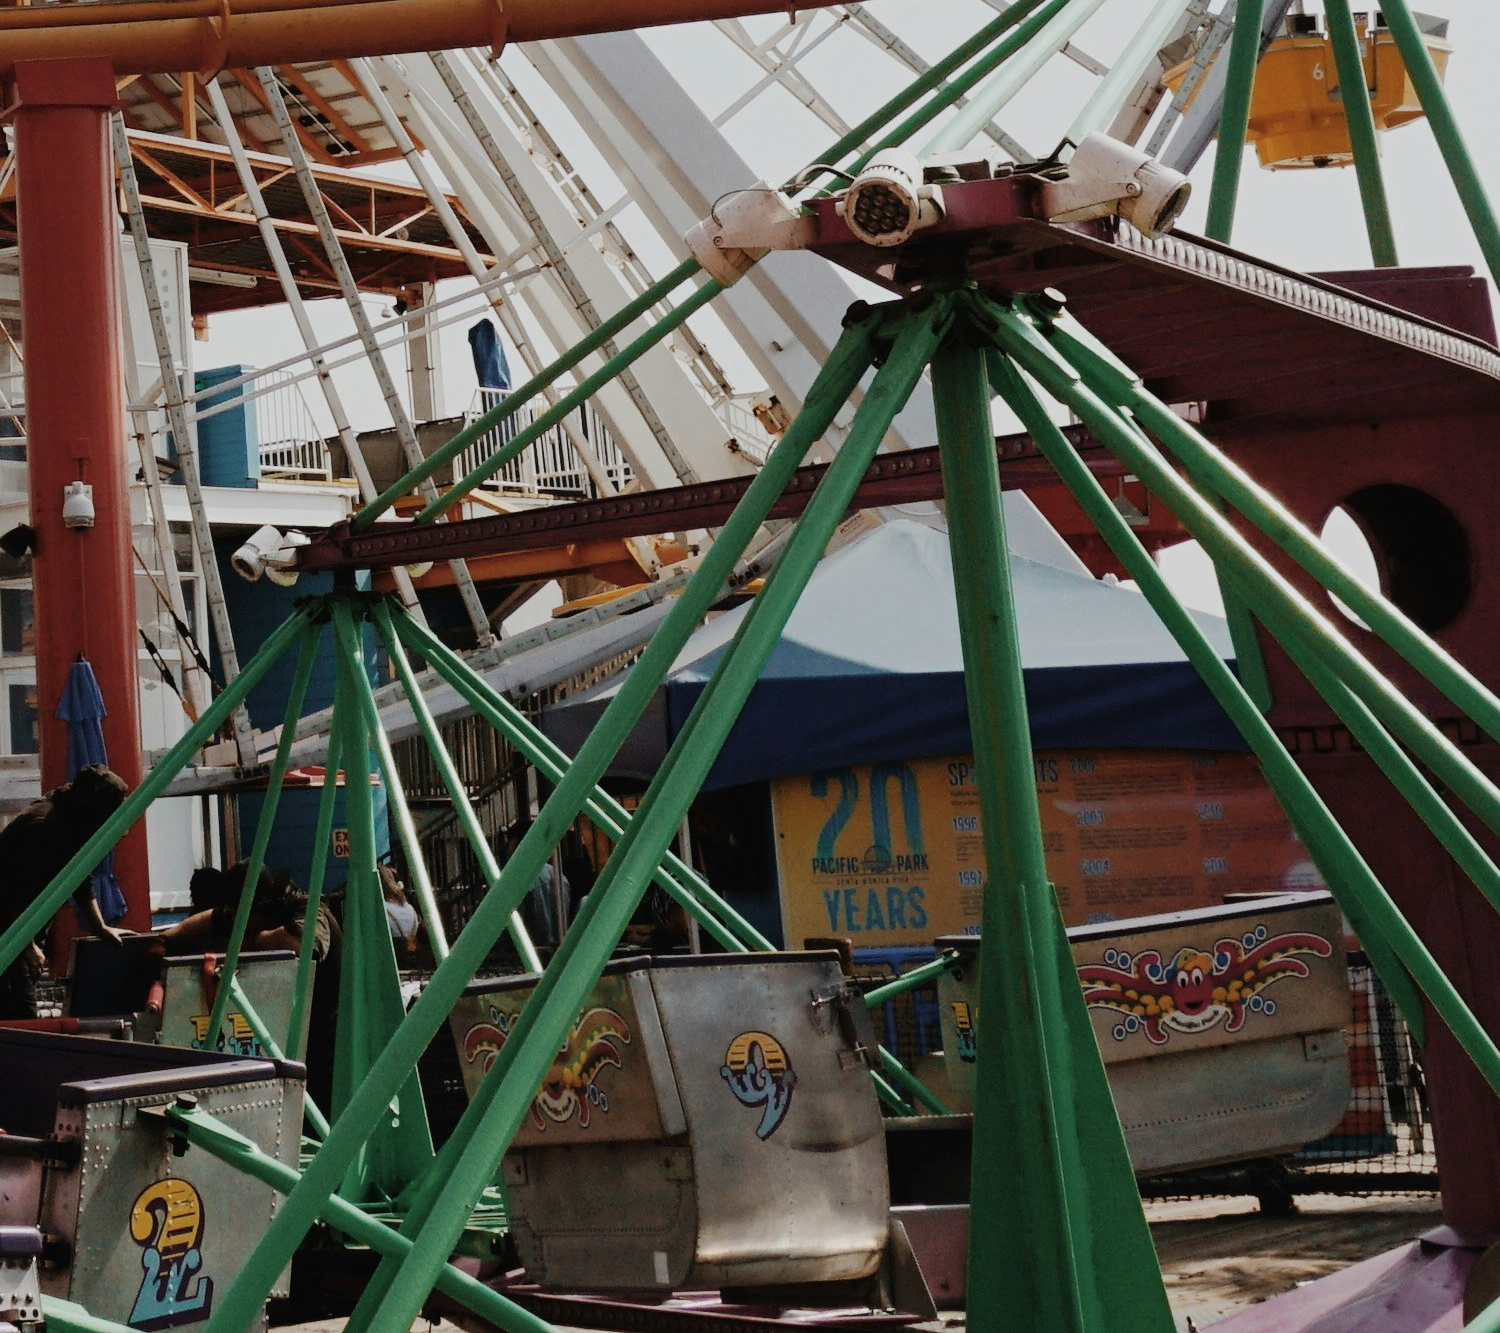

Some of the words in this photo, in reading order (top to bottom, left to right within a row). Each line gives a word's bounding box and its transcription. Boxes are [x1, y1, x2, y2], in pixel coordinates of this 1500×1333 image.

[1312, 63, 1325, 81] 6
[812, 856, 860, 875] PACIFIC
[896, 854, 929, 872] PARK
[822, 885, 929, 932] YEARS
[719, 1030, 798, 1142] 9
[128, 1177, 214, 1332] 2
